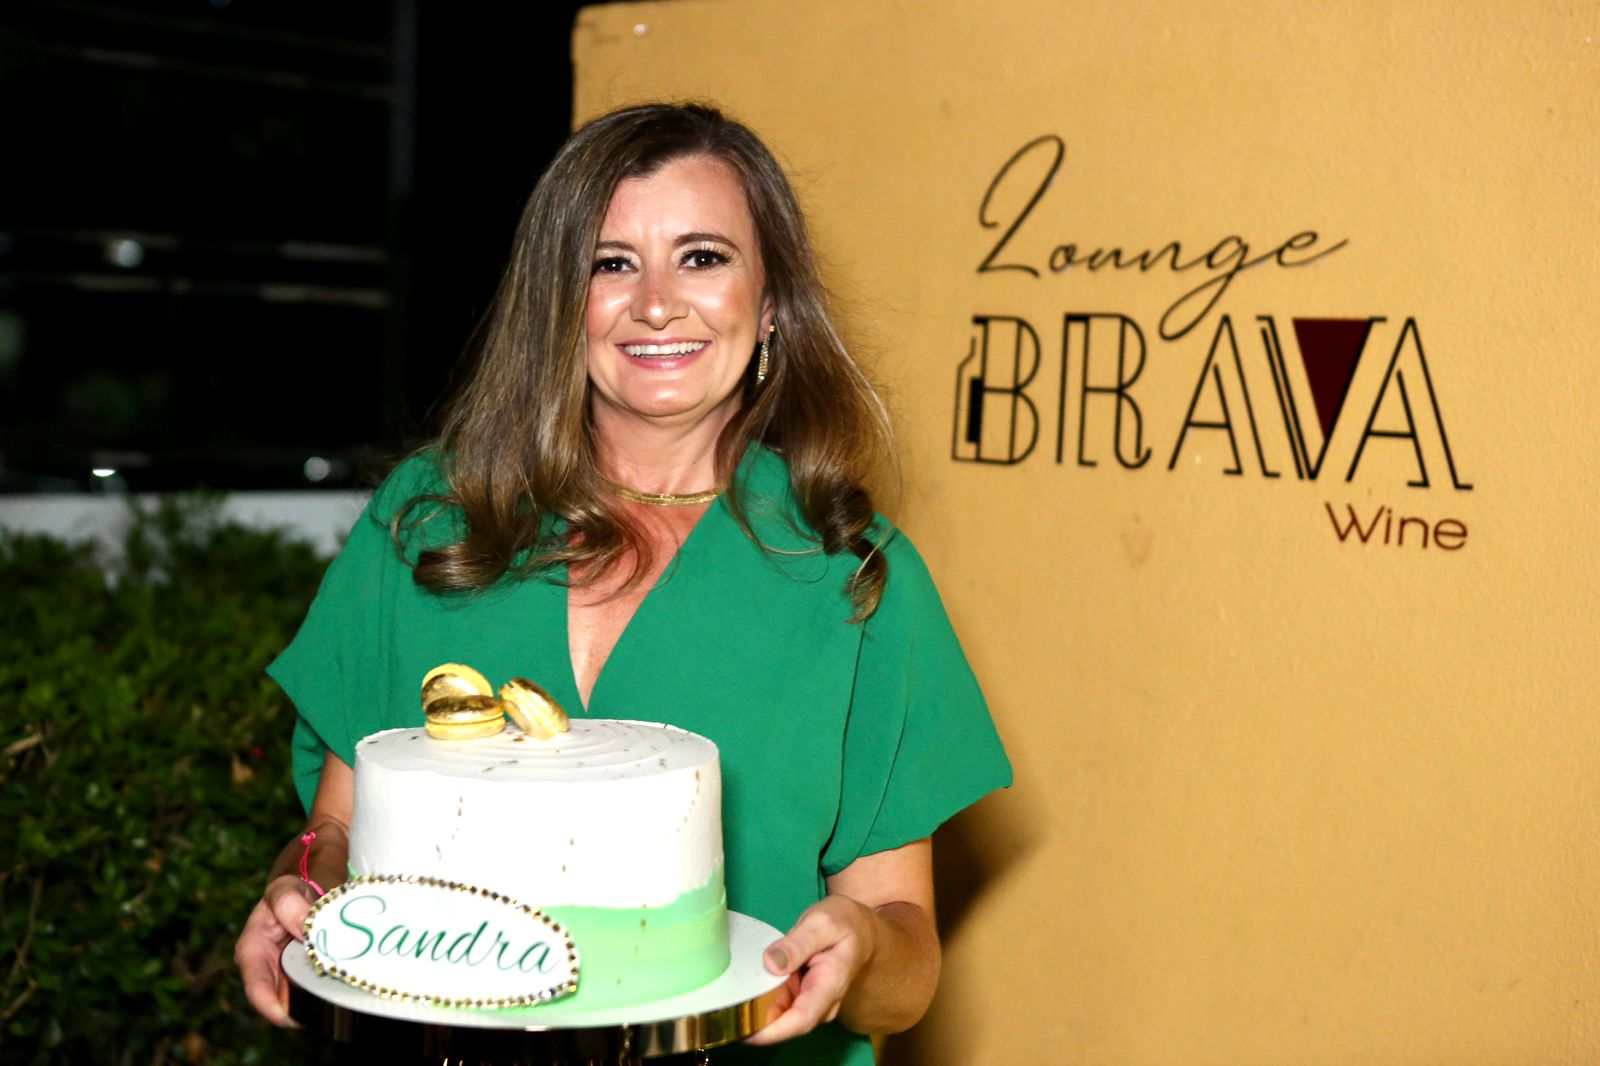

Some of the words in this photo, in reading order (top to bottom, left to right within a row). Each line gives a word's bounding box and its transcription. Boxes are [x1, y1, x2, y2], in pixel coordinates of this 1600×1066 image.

[977, 134, 1349, 341] Lounge
[952, 312, 1474, 490] BRAVA
[1325, 502, 1468, 551] Wine
[316, 894, 559, 974] Sandra
